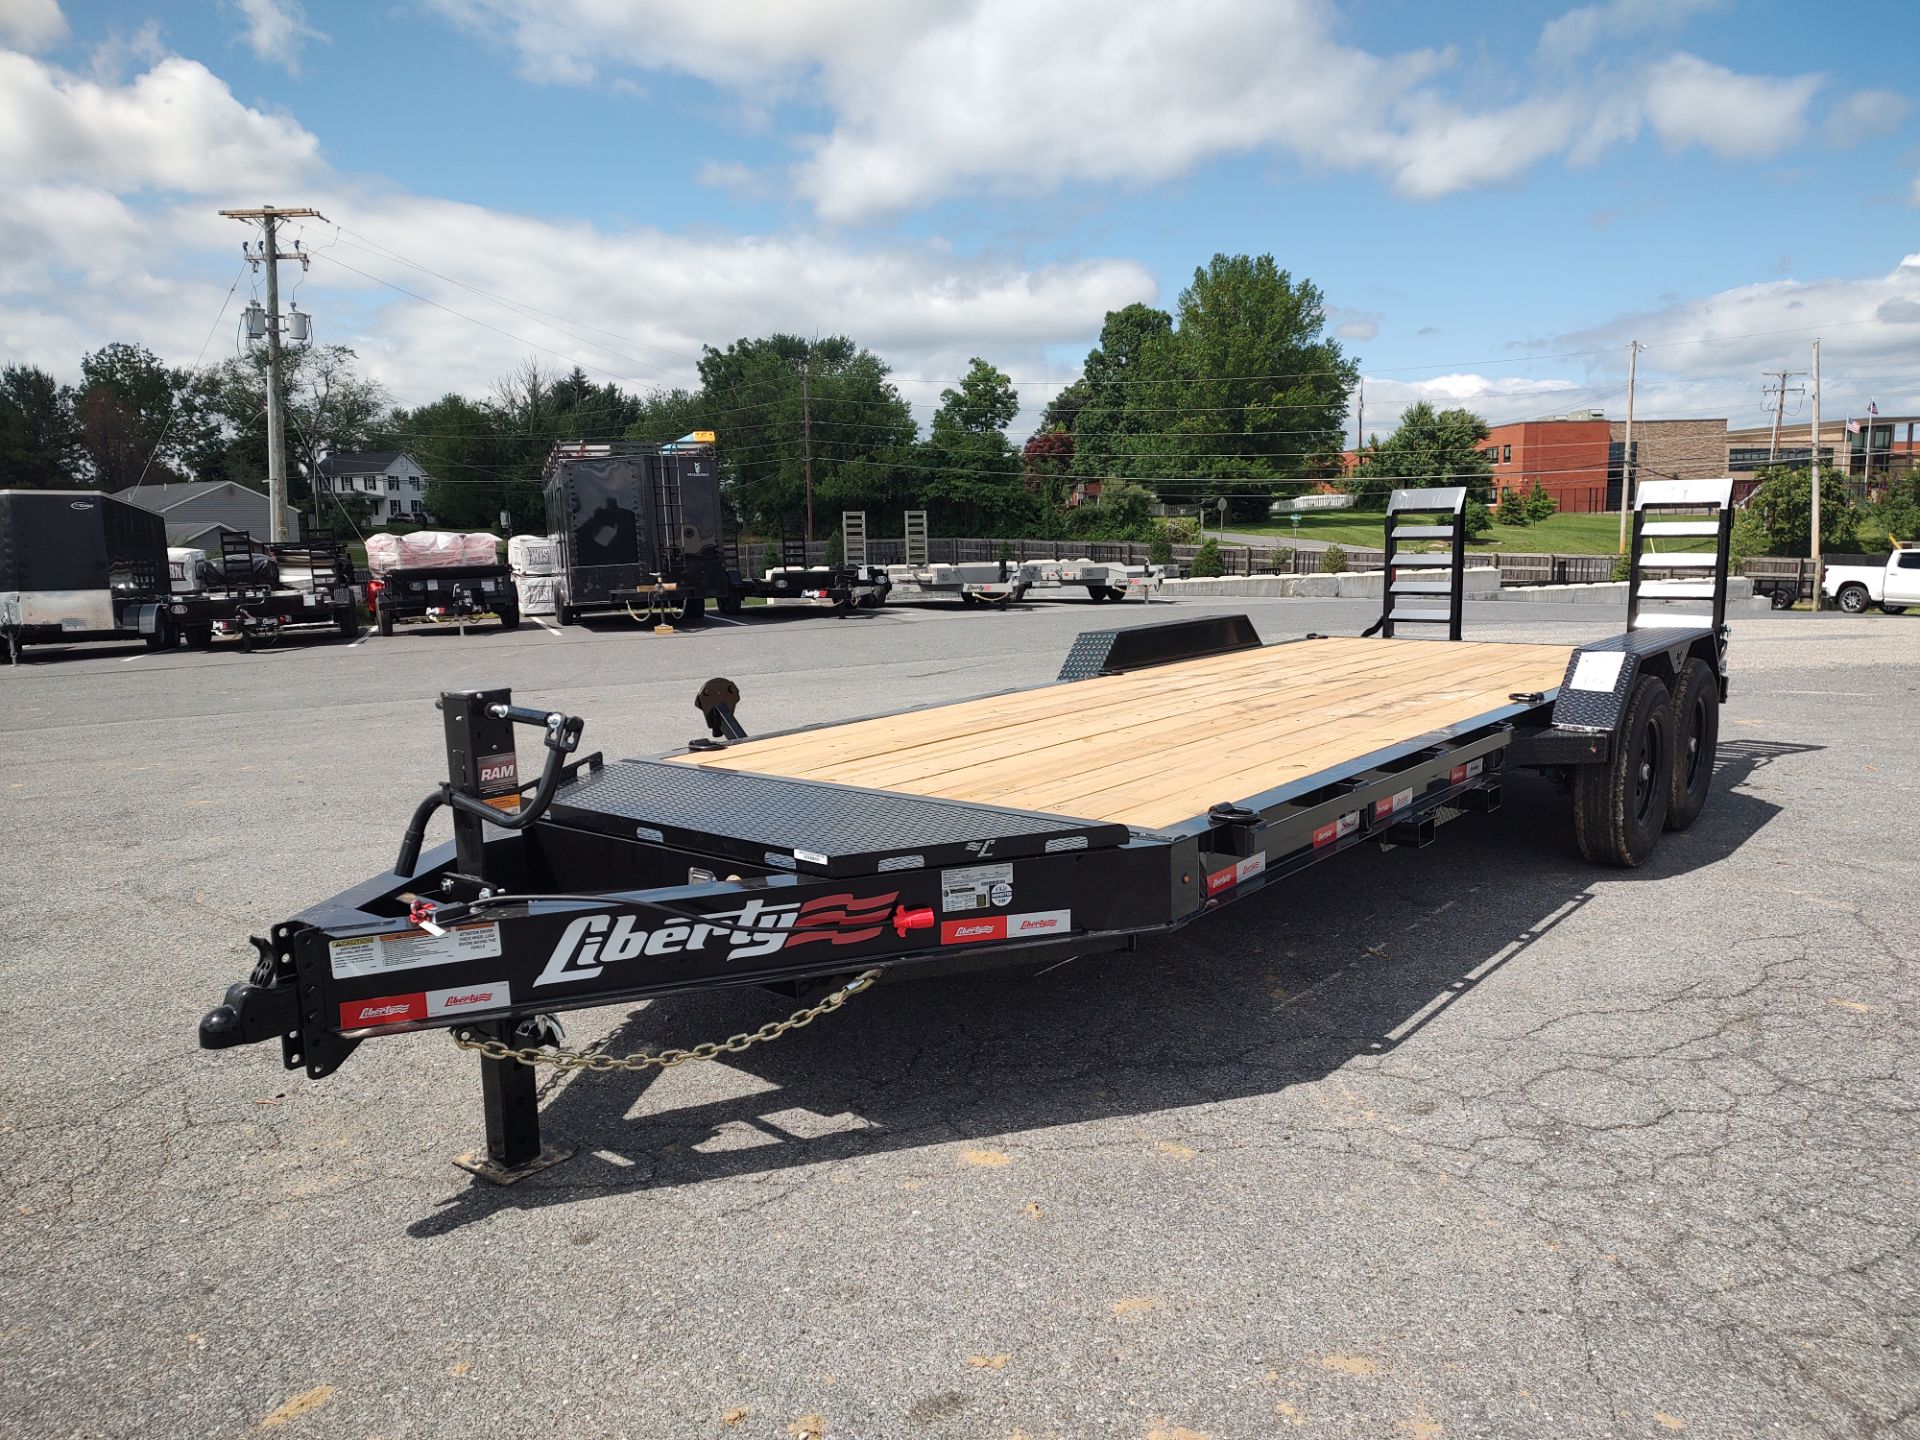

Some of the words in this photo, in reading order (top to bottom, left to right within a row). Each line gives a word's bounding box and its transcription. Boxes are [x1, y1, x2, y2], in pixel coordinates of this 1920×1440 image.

[481, 765, 515, 782] RAM
[532, 899, 801, 988] Liberty
[445, 993, 479, 1007] Liberty
[359, 1005, 398, 1020] Liberty
